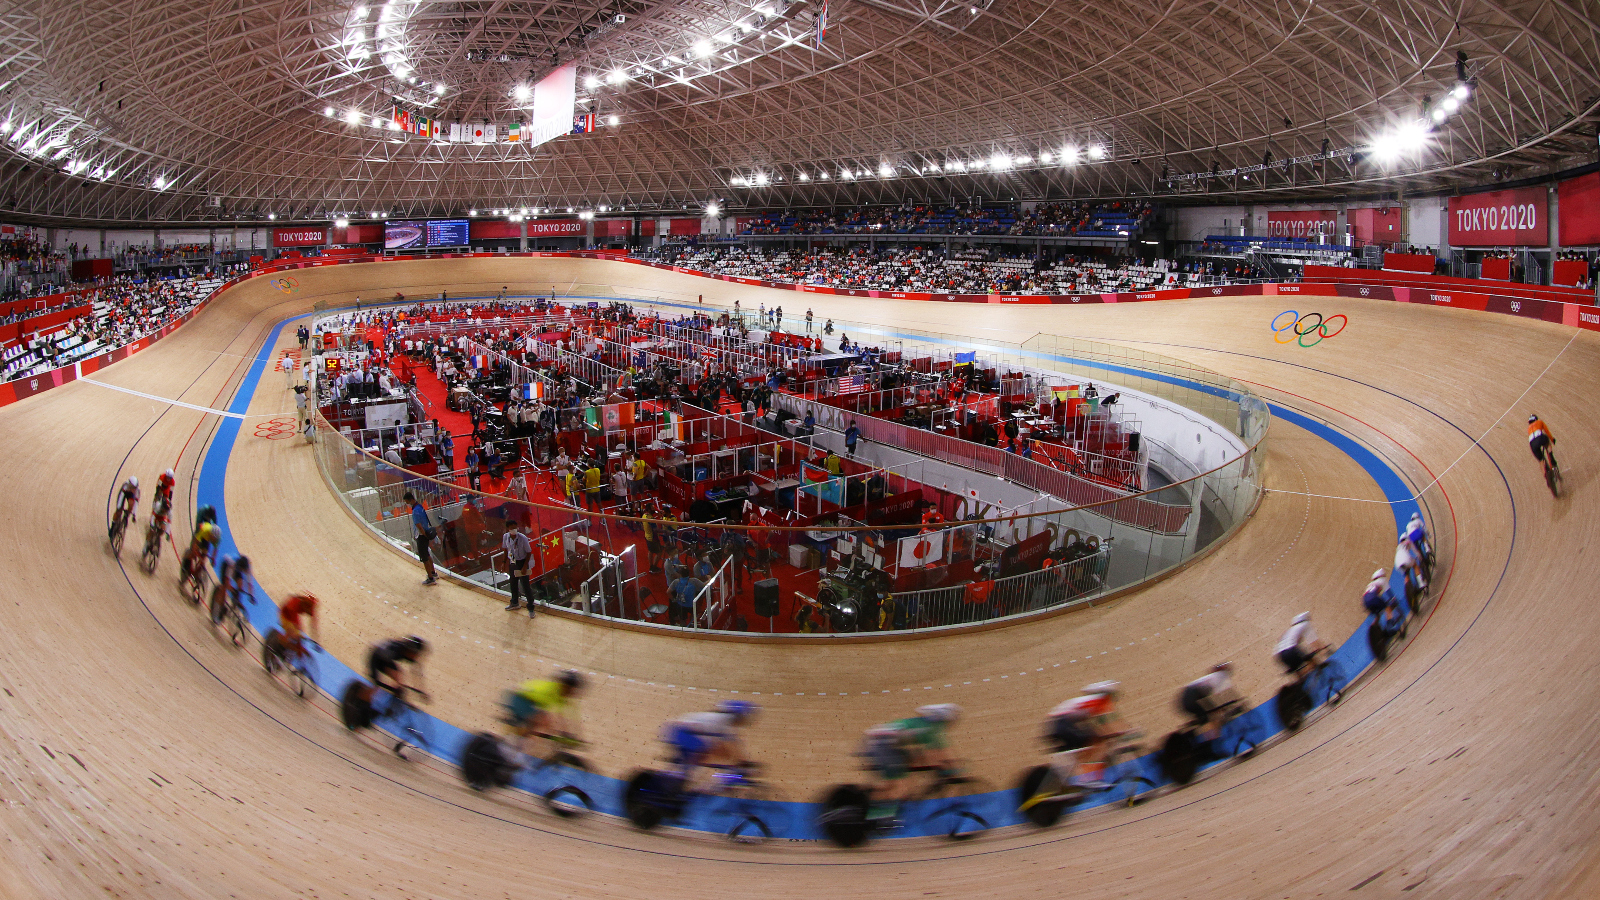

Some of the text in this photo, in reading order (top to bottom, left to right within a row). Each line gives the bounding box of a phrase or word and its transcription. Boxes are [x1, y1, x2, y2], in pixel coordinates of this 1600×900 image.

[1457, 203, 1536, 232] TOKYO 2020
[532, 223, 581, 233] TOKYO 2020
[1269, 220, 1335, 237] TOKYO 200
[279, 231, 322, 242] TOKYO 2020
[327, 359, 338, 368] 52
[343, 408, 365, 417] TOKYO
[881, 504, 899, 515] OKYO
